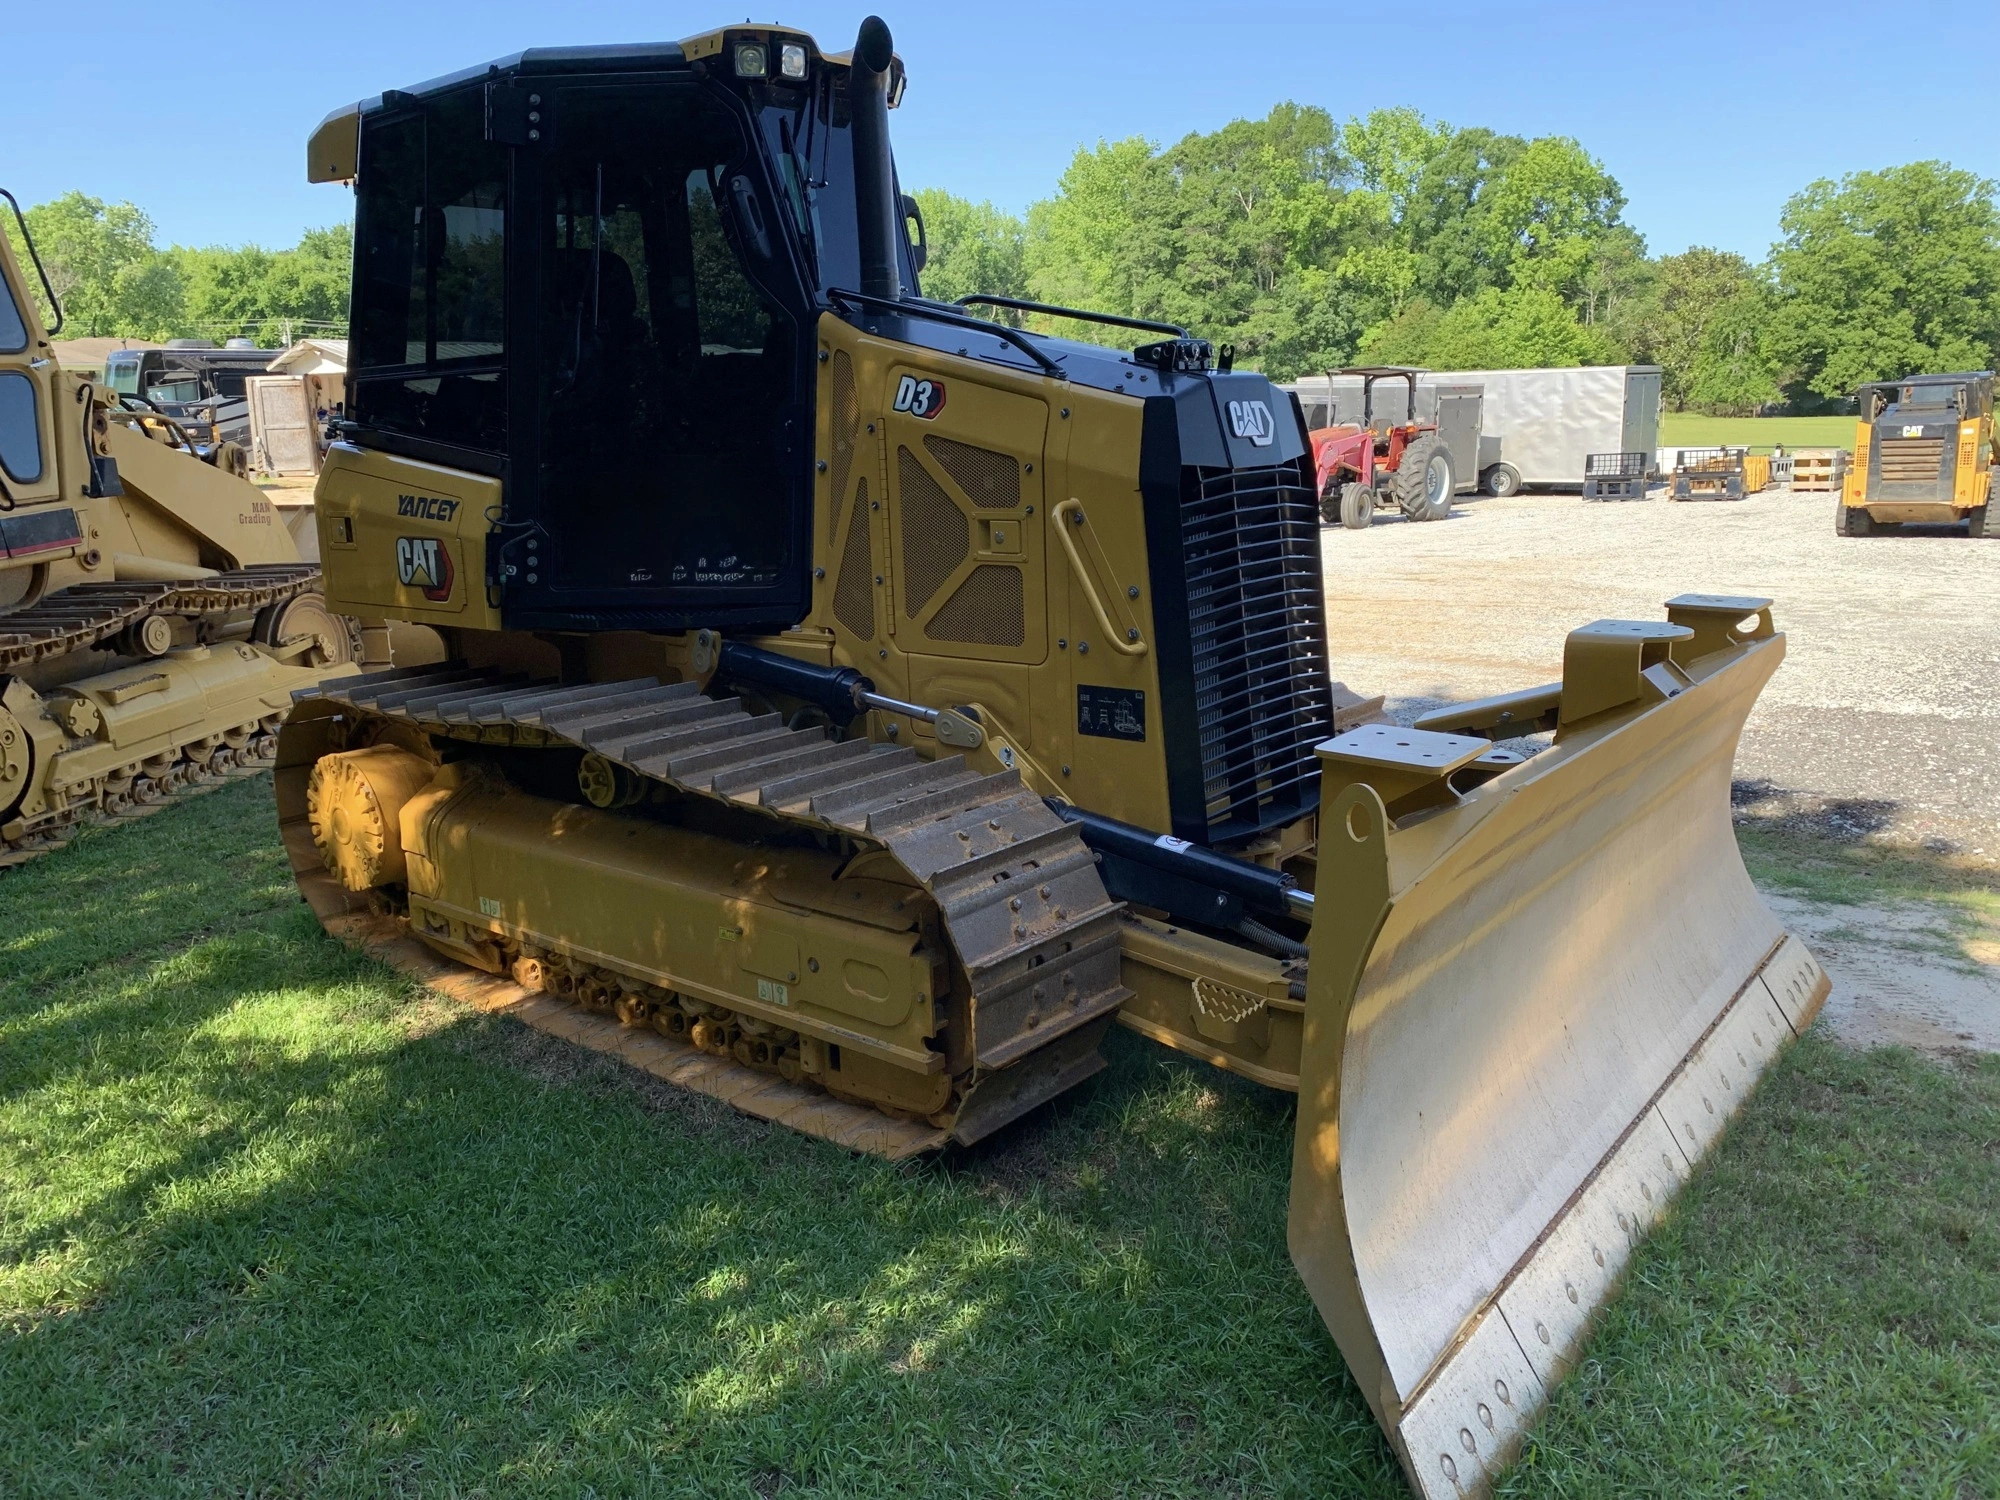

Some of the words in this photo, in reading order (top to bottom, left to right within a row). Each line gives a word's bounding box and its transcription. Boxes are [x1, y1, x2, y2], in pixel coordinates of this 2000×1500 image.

[894, 375, 933, 415] D3
[1229, 400, 1265, 437] CAT
[1902, 425, 1925, 437] CAT
[239, 513, 272, 526] Grading
[397, 494, 461, 522] YANCEY
[396, 537, 439, 587] CAT
